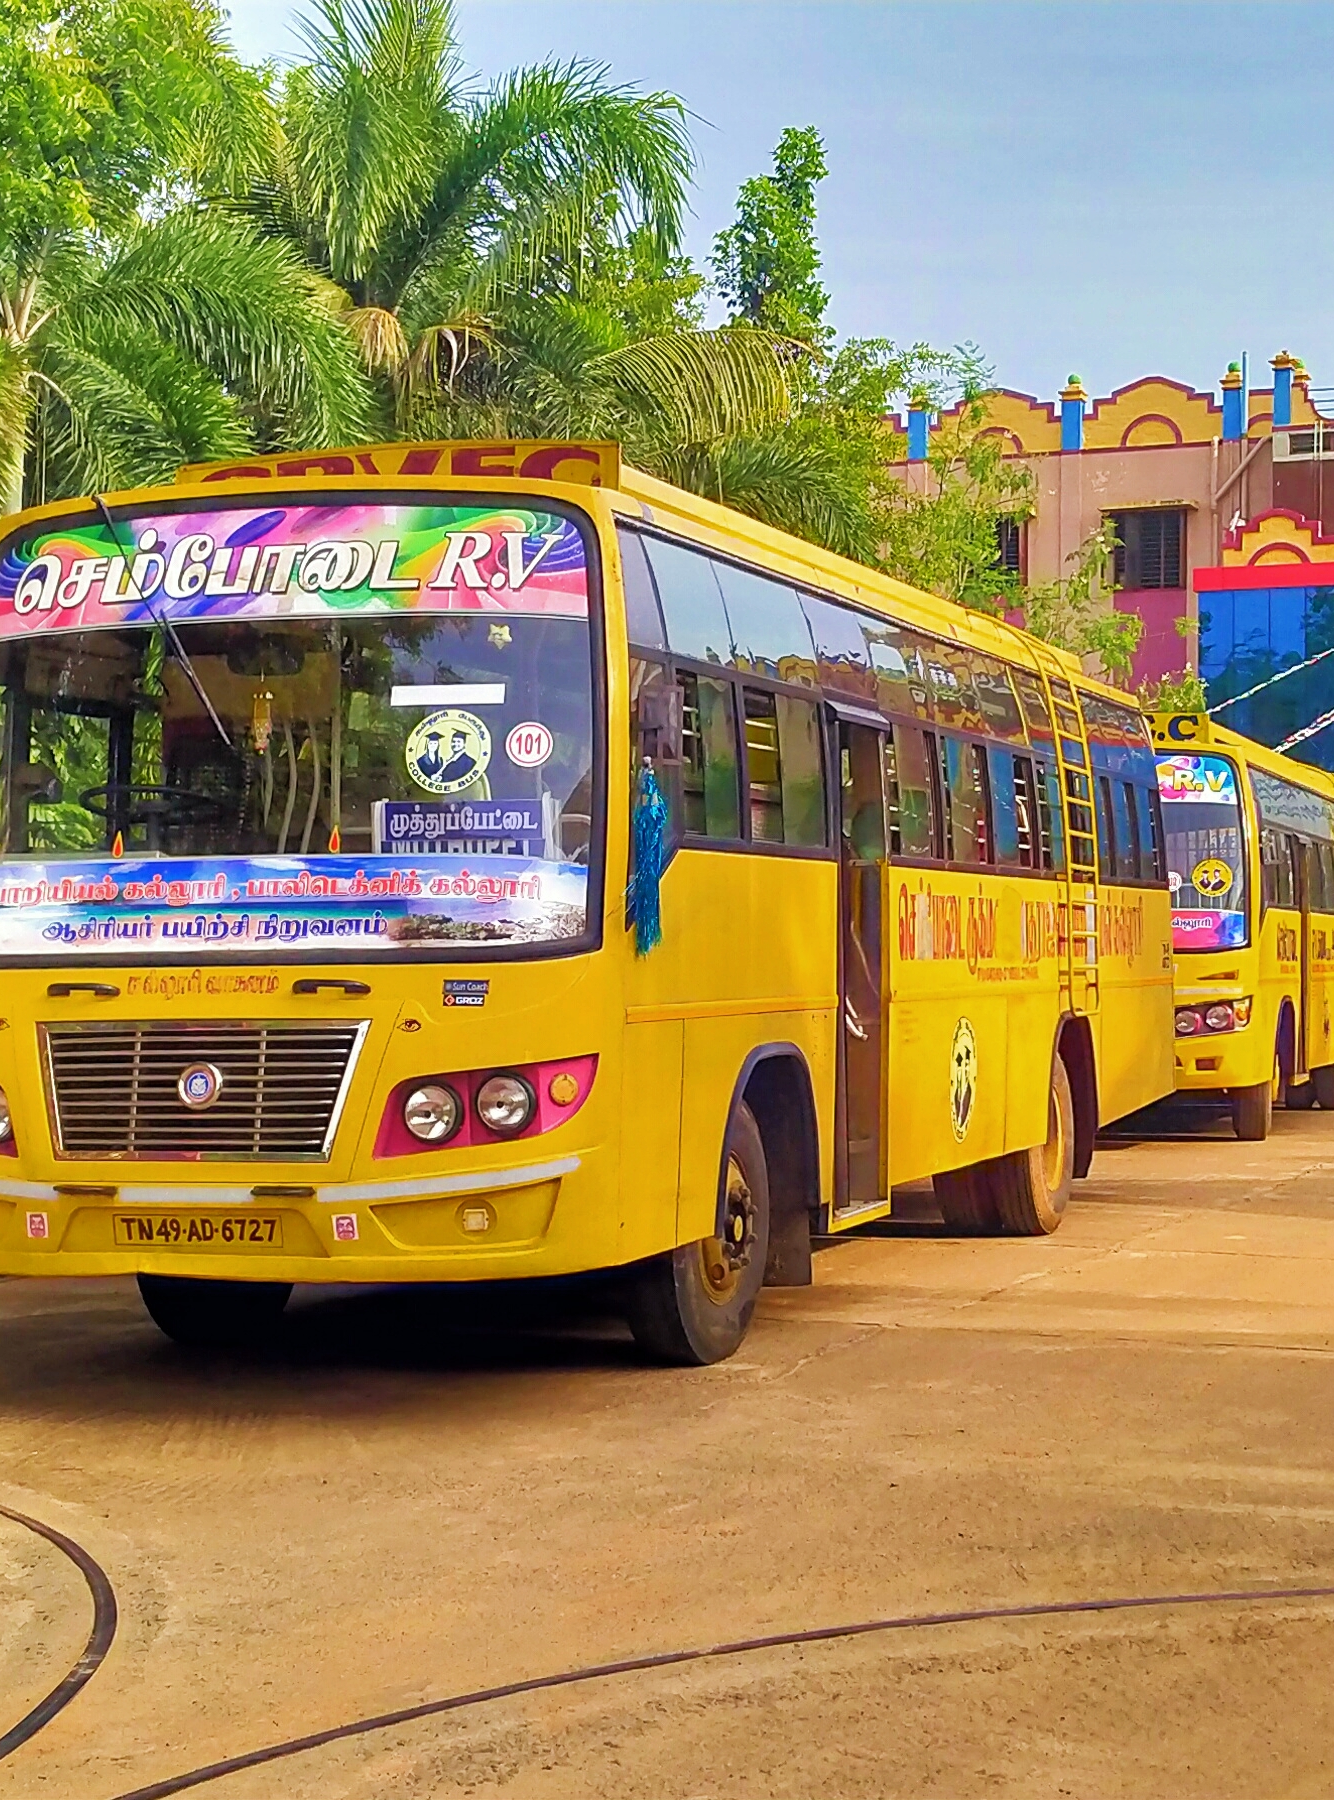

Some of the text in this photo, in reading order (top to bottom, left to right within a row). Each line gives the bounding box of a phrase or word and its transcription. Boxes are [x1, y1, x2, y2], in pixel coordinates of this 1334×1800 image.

[14, 528, 565, 615] செம்போடை R.V
[515, 733, 542, 756] 101
[408, 761, 480, 791] COLLEGE BUS
[1172, 769, 1228, 792] R.V
[389, 804, 538, 839] முத்துப்பேட்டை
[246, 868, 424, 899] பாலிடெக்னிக்
[428, 868, 544, 904] கல்லூரி
[42, 910, 389, 943] ஆசிரியர் பயிற்சி நிறுவனம்
